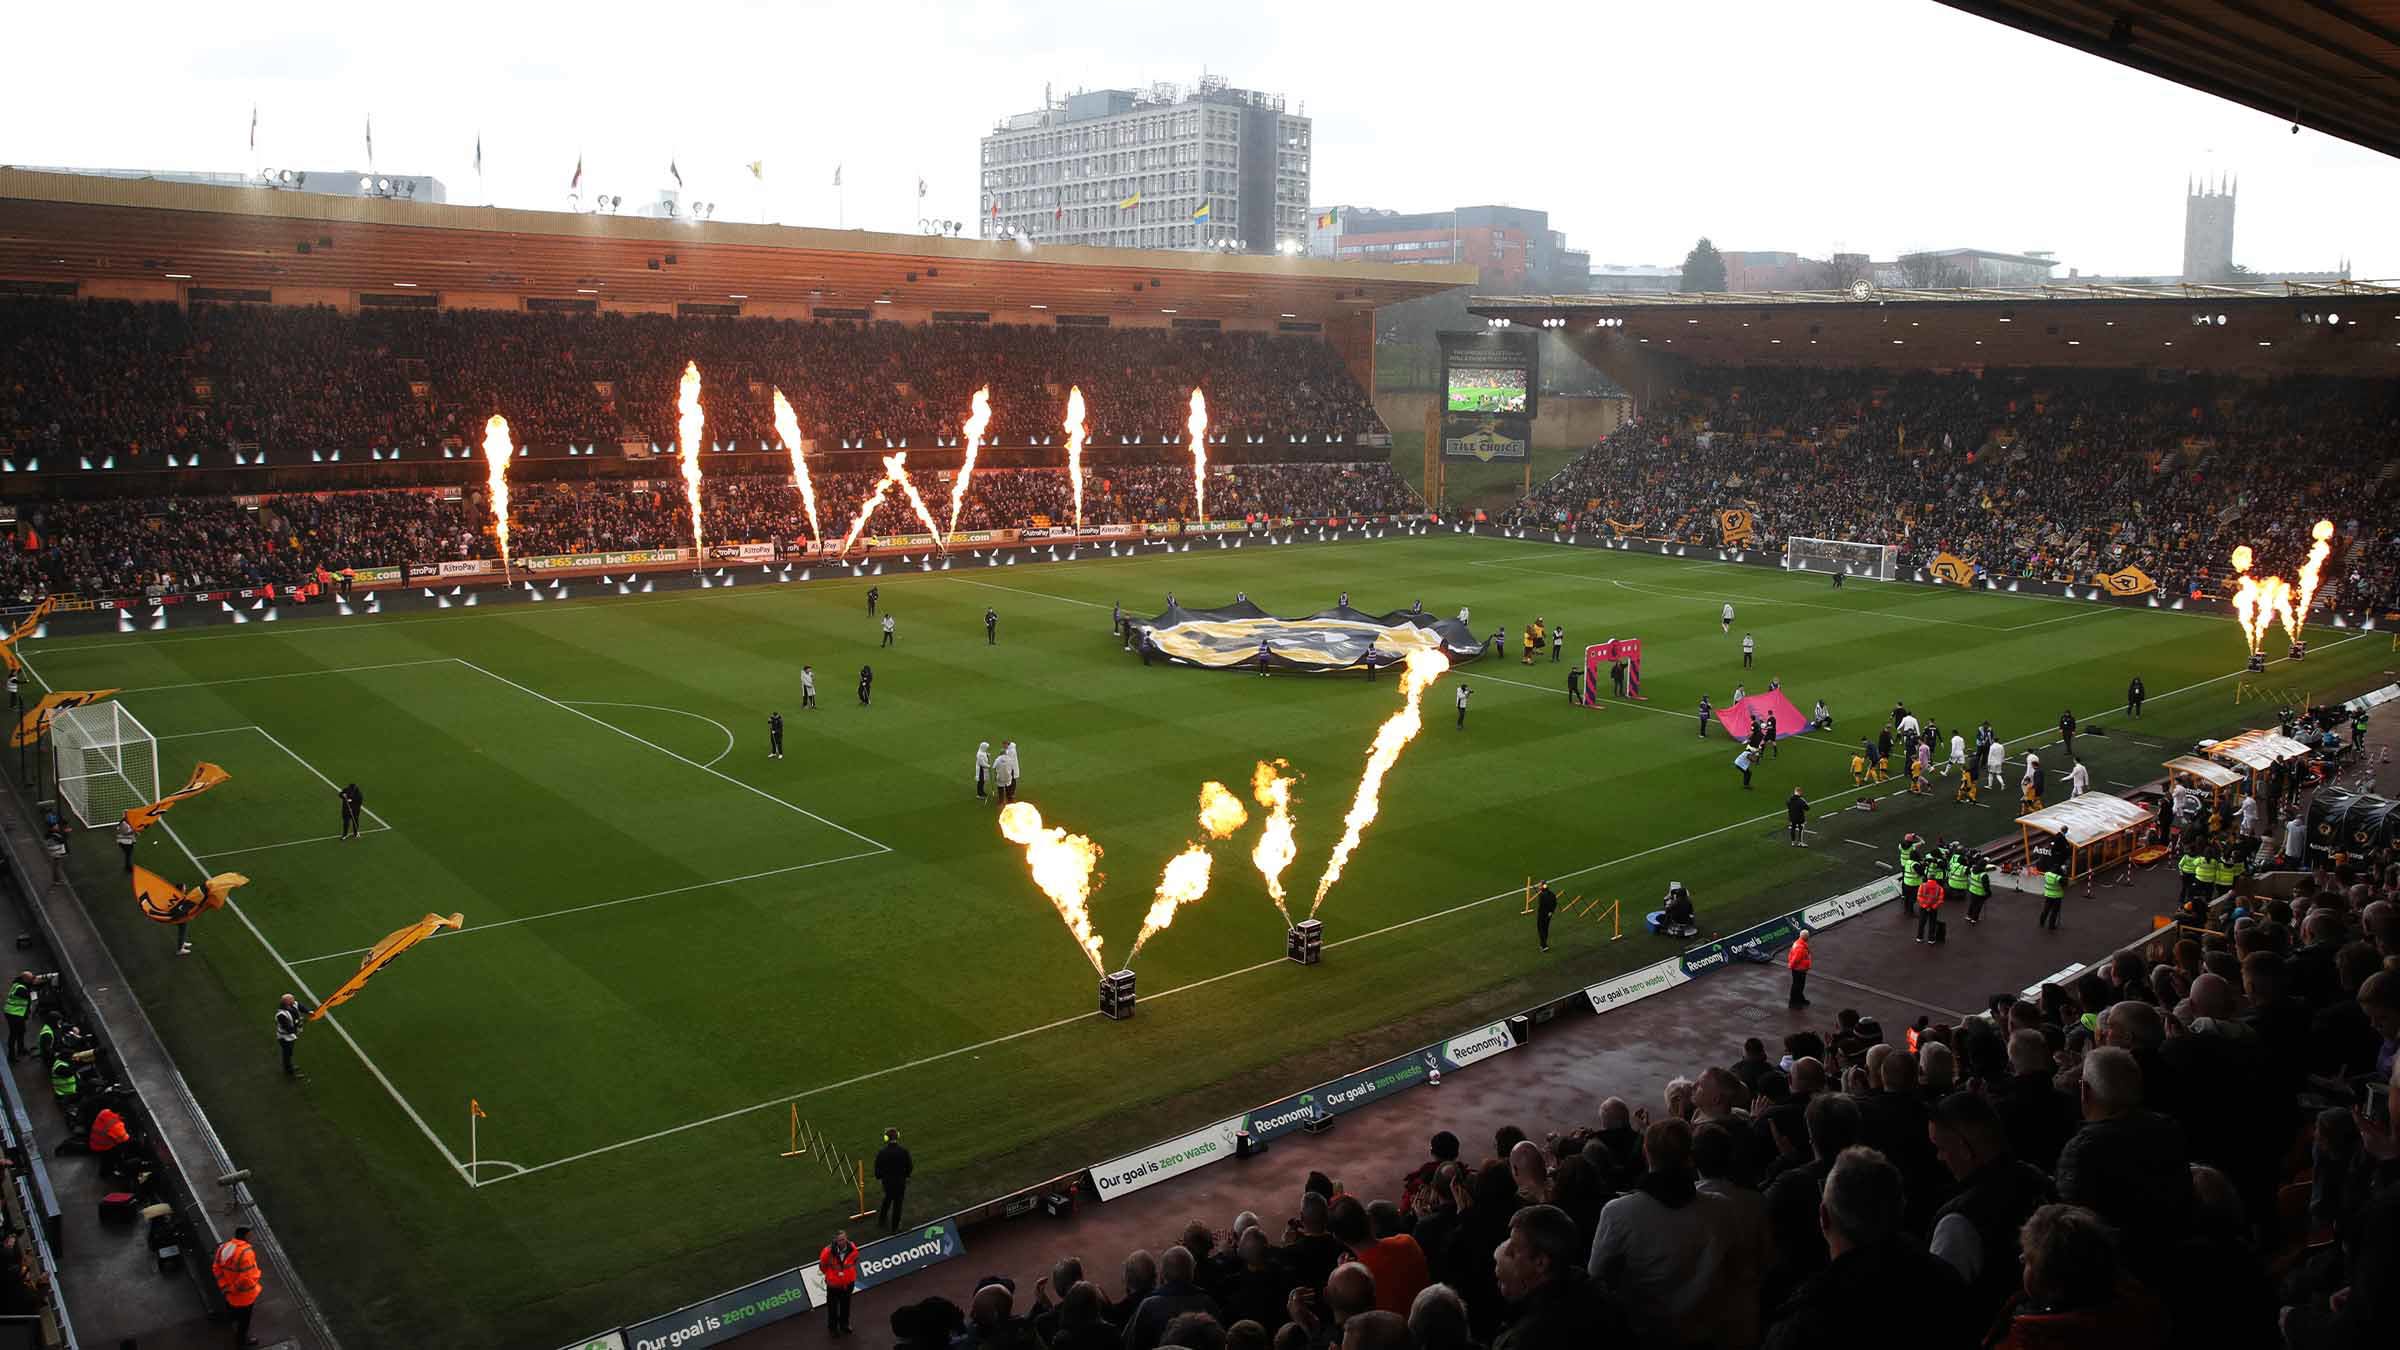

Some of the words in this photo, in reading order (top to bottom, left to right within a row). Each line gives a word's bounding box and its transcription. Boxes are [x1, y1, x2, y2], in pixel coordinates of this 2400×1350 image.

[941, 534, 990, 543] et365.com
[443, 563, 477, 573] AstroPay
[528, 557, 602, 569] bet365.com
[606, 553, 676, 565] bet365.com
[353, 571, 401, 582] 365.com
[409, 566, 438, 576] stroPay
[1809, 906, 1840, 924] Reconomy
[1687, 951, 1723, 972] Reconomy
[1592, 994, 1607, 1005] Our
[1607, 987, 1623, 1001] goal
[1623, 985, 1631, 996] is
[1630, 981, 1645, 994] zero
[1645, 974, 1665, 988] waste
[1453, 1034, 1502, 1060] Reconomy
[1254, 1104, 1314, 1134] Reconomy
[1327, 1092, 1346, 1106] Our
[1346, 1084, 1366, 1103] goal
[1366, 1081, 1376, 1093] is
[1375, 1074, 1396, 1090] zero
[1396, 1064, 1424, 1082] waste
[1099, 1174, 1122, 1190] Our
[1122, 1163, 1148, 1185] goal
[1148, 1160, 1159, 1173] is
[1159, 1152, 1185, 1170] zero
[1184, 1140, 1217, 1160] waste
[859, 1238, 942, 1278] Reconomy
[636, 1334, 668, 1350] Our
[669, 1319, 705, 1348] goal
[705, 1315, 721, 1331] is
[722, 1300, 757, 1327] zero
[757, 1286, 802, 1315] waste
